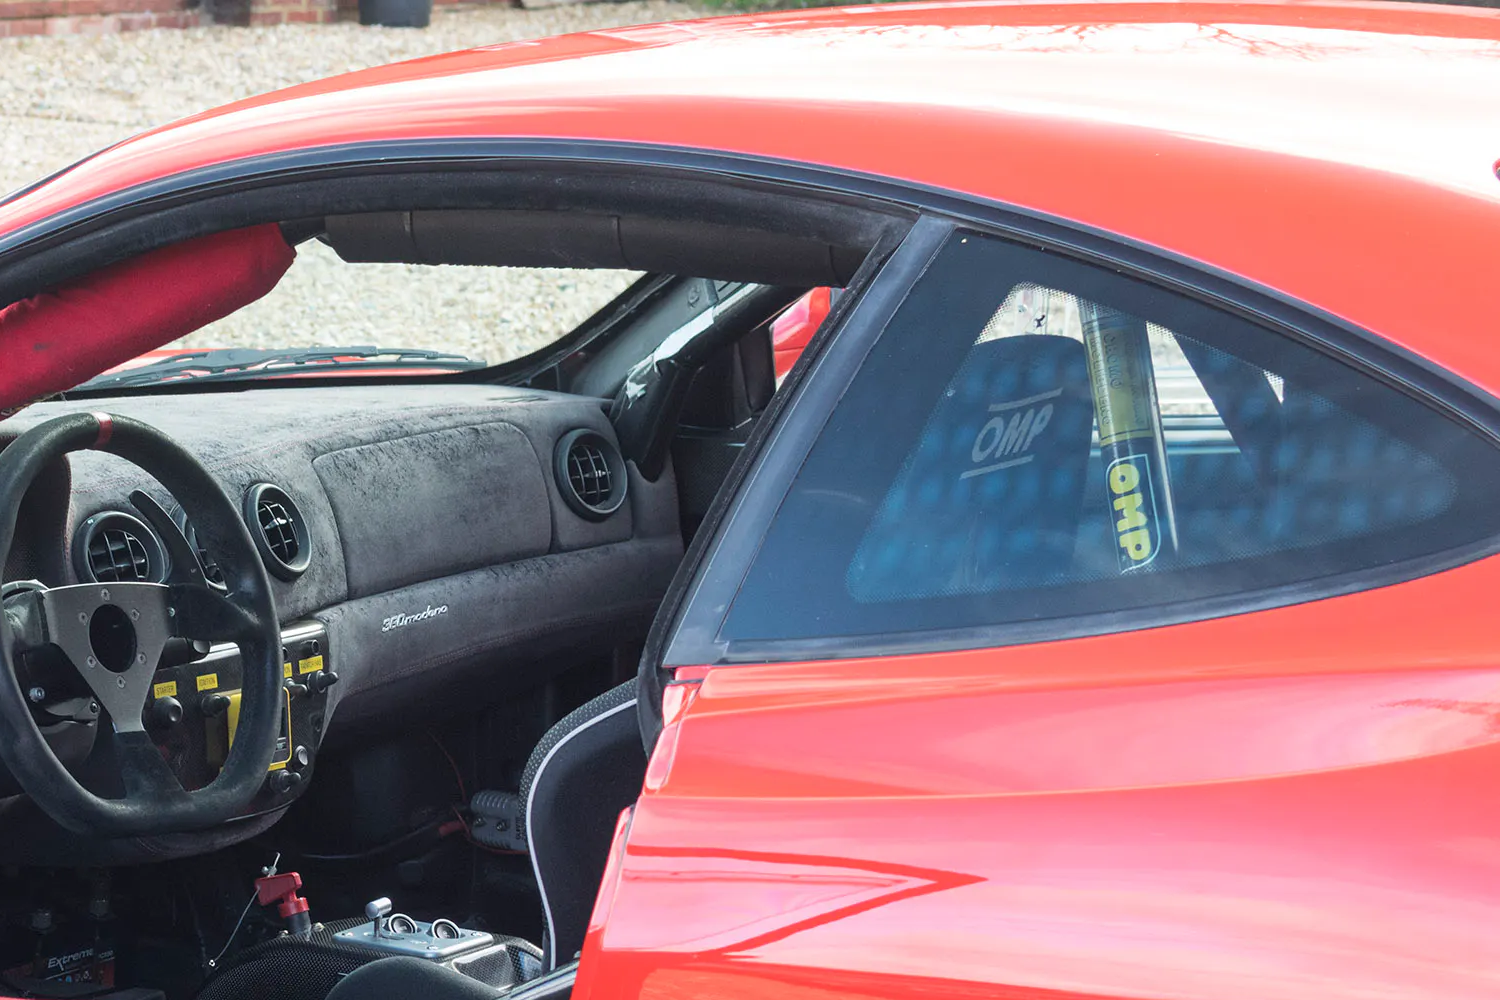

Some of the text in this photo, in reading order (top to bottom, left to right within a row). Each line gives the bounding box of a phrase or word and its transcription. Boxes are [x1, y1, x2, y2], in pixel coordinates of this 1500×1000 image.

[972, 403, 1054, 463] OMP
[1109, 463, 1151, 560] OMP
[47, 948, 94, 971] Extreme
